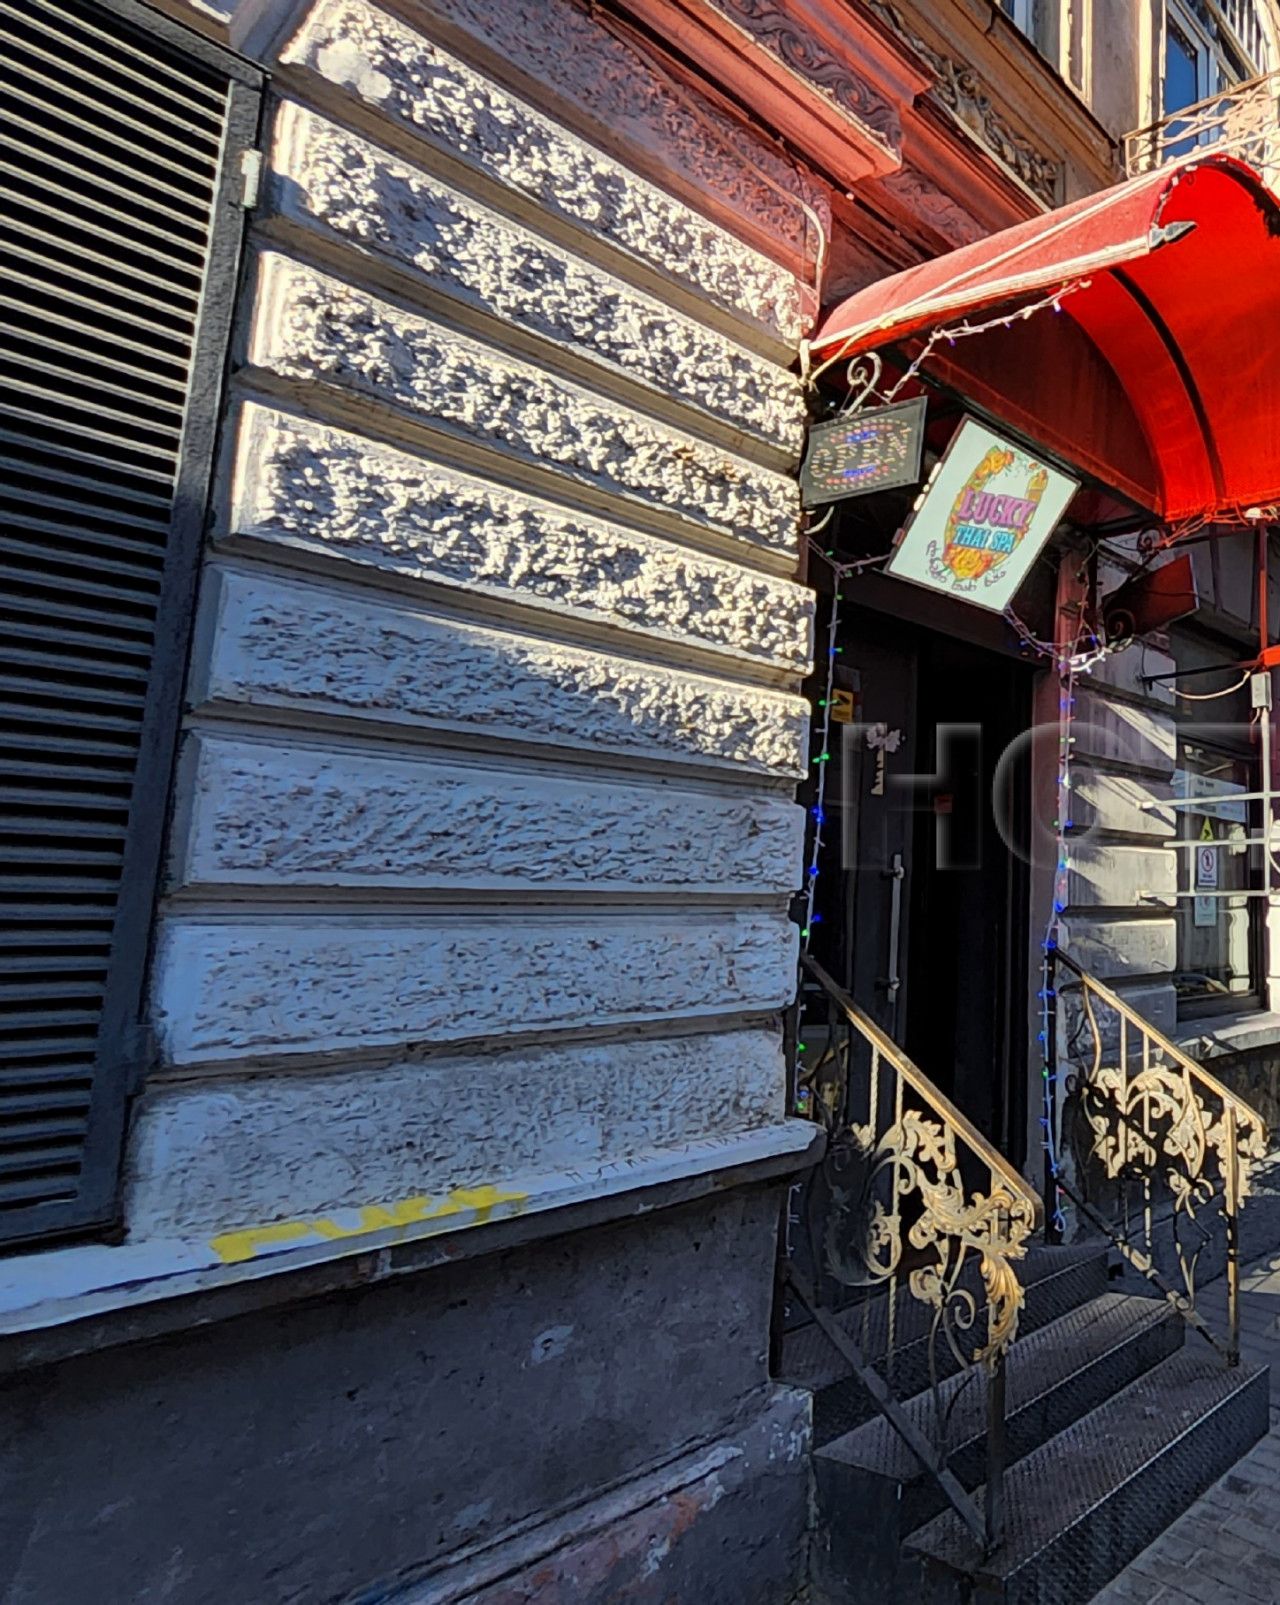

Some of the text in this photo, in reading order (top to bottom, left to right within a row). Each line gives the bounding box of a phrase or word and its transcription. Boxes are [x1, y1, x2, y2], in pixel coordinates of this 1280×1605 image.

[810, 428, 912, 478] OPEN
[957, 488, 1038, 530] LUCKY
[953, 523, 1016, 555] THAI SPA
